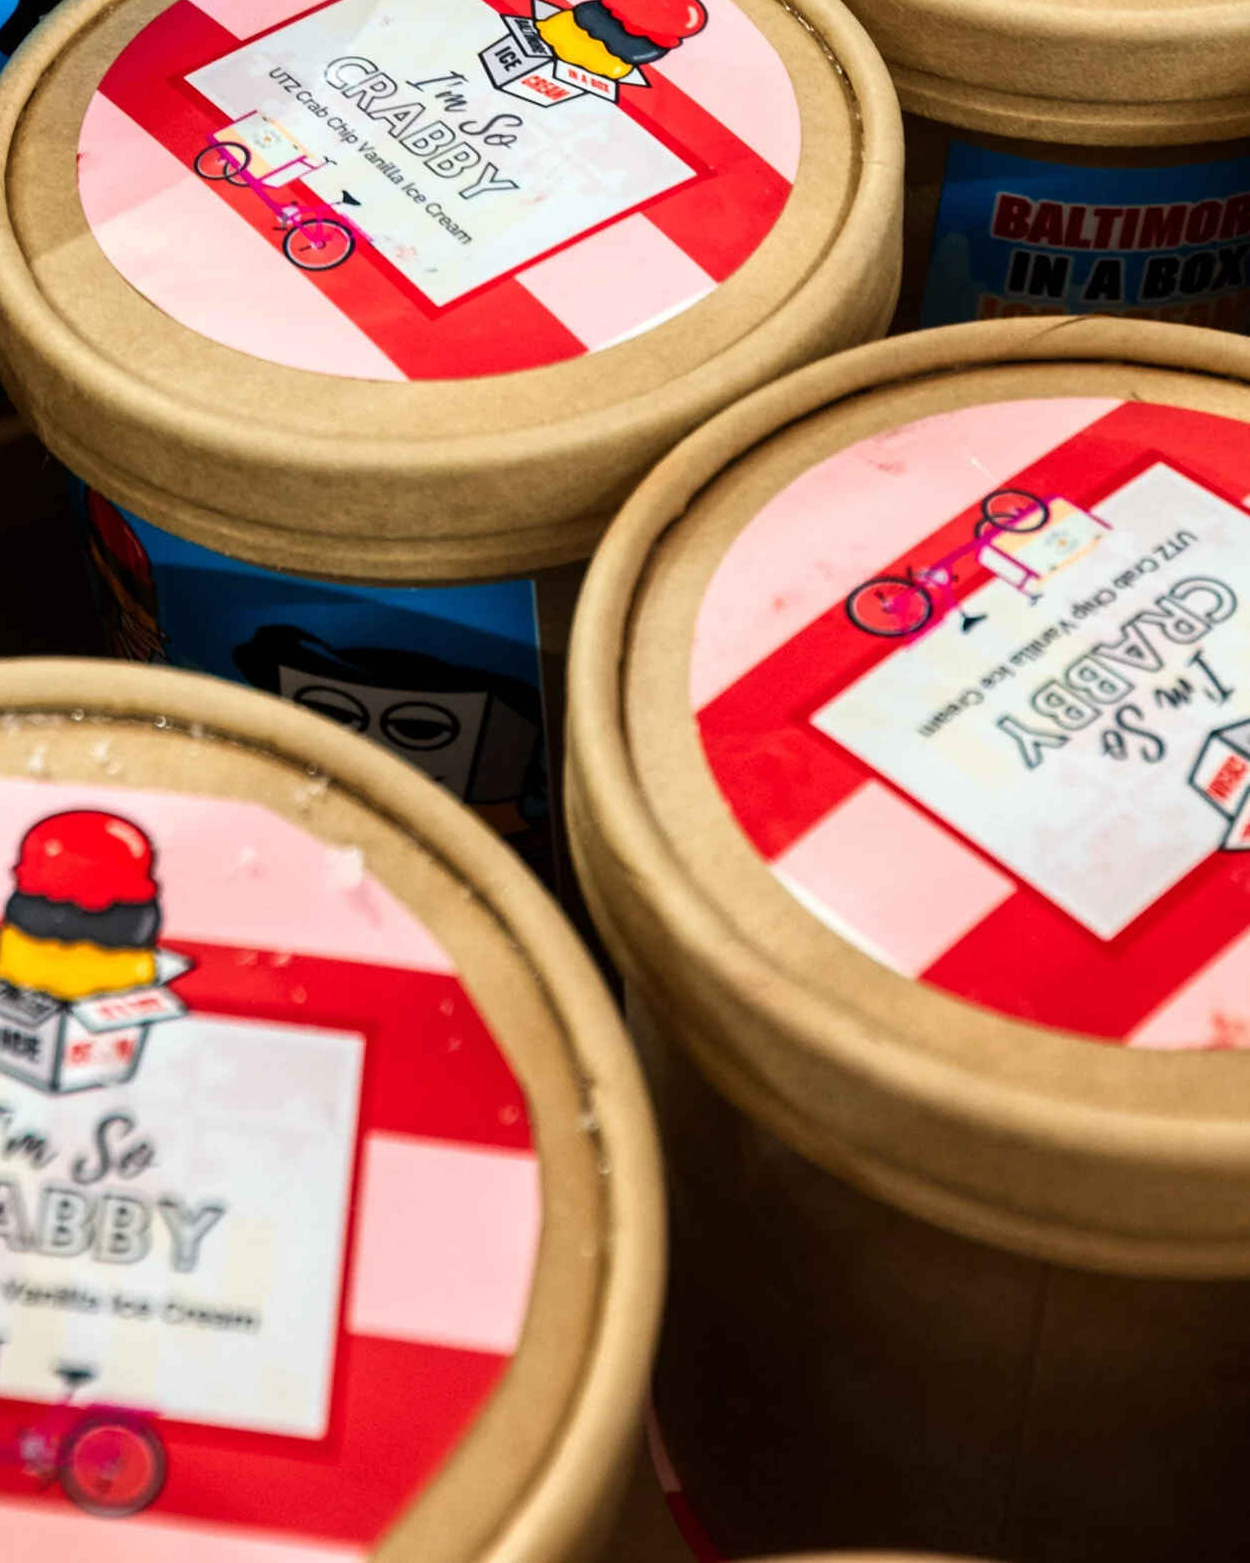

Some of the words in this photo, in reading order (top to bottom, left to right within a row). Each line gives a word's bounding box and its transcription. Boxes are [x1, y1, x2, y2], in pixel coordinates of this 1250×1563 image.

[494, 45, 522, 72] ICE
[521, 74, 570, 101] CREAM
[324, 56, 520, 200] CRABBY
[406, 69, 470, 113] I'm
[458, 113, 524, 149] So
[269, 66, 302, 94] UTZ
[295, 89, 329, 119] Crab
[327, 113, 360, 146] Chip
[358, 141, 405, 186] Vanilla
[401, 181, 427, 205] Ice
[425, 201, 473, 245] Cream
[1006, 249, 1070, 300] IN
[1083, 257, 1125, 302] A
[1139, 244, 1250, 301] BOX
[1112, 557, 1160, 591] Crab
[1152, 529, 1199, 562] UTZ
[1070, 587, 1118, 620] Chip
[1008, 619, 1079, 668] Vanilla
[979, 664, 1018, 690] Ice
[996, 575, 1238, 771] CRABBY
[1154, 649, 1235, 708] I'm
[916, 688, 985, 738] Cream
[1100, 704, 1168, 764] So
[70, 1111, 157, 1185] So
